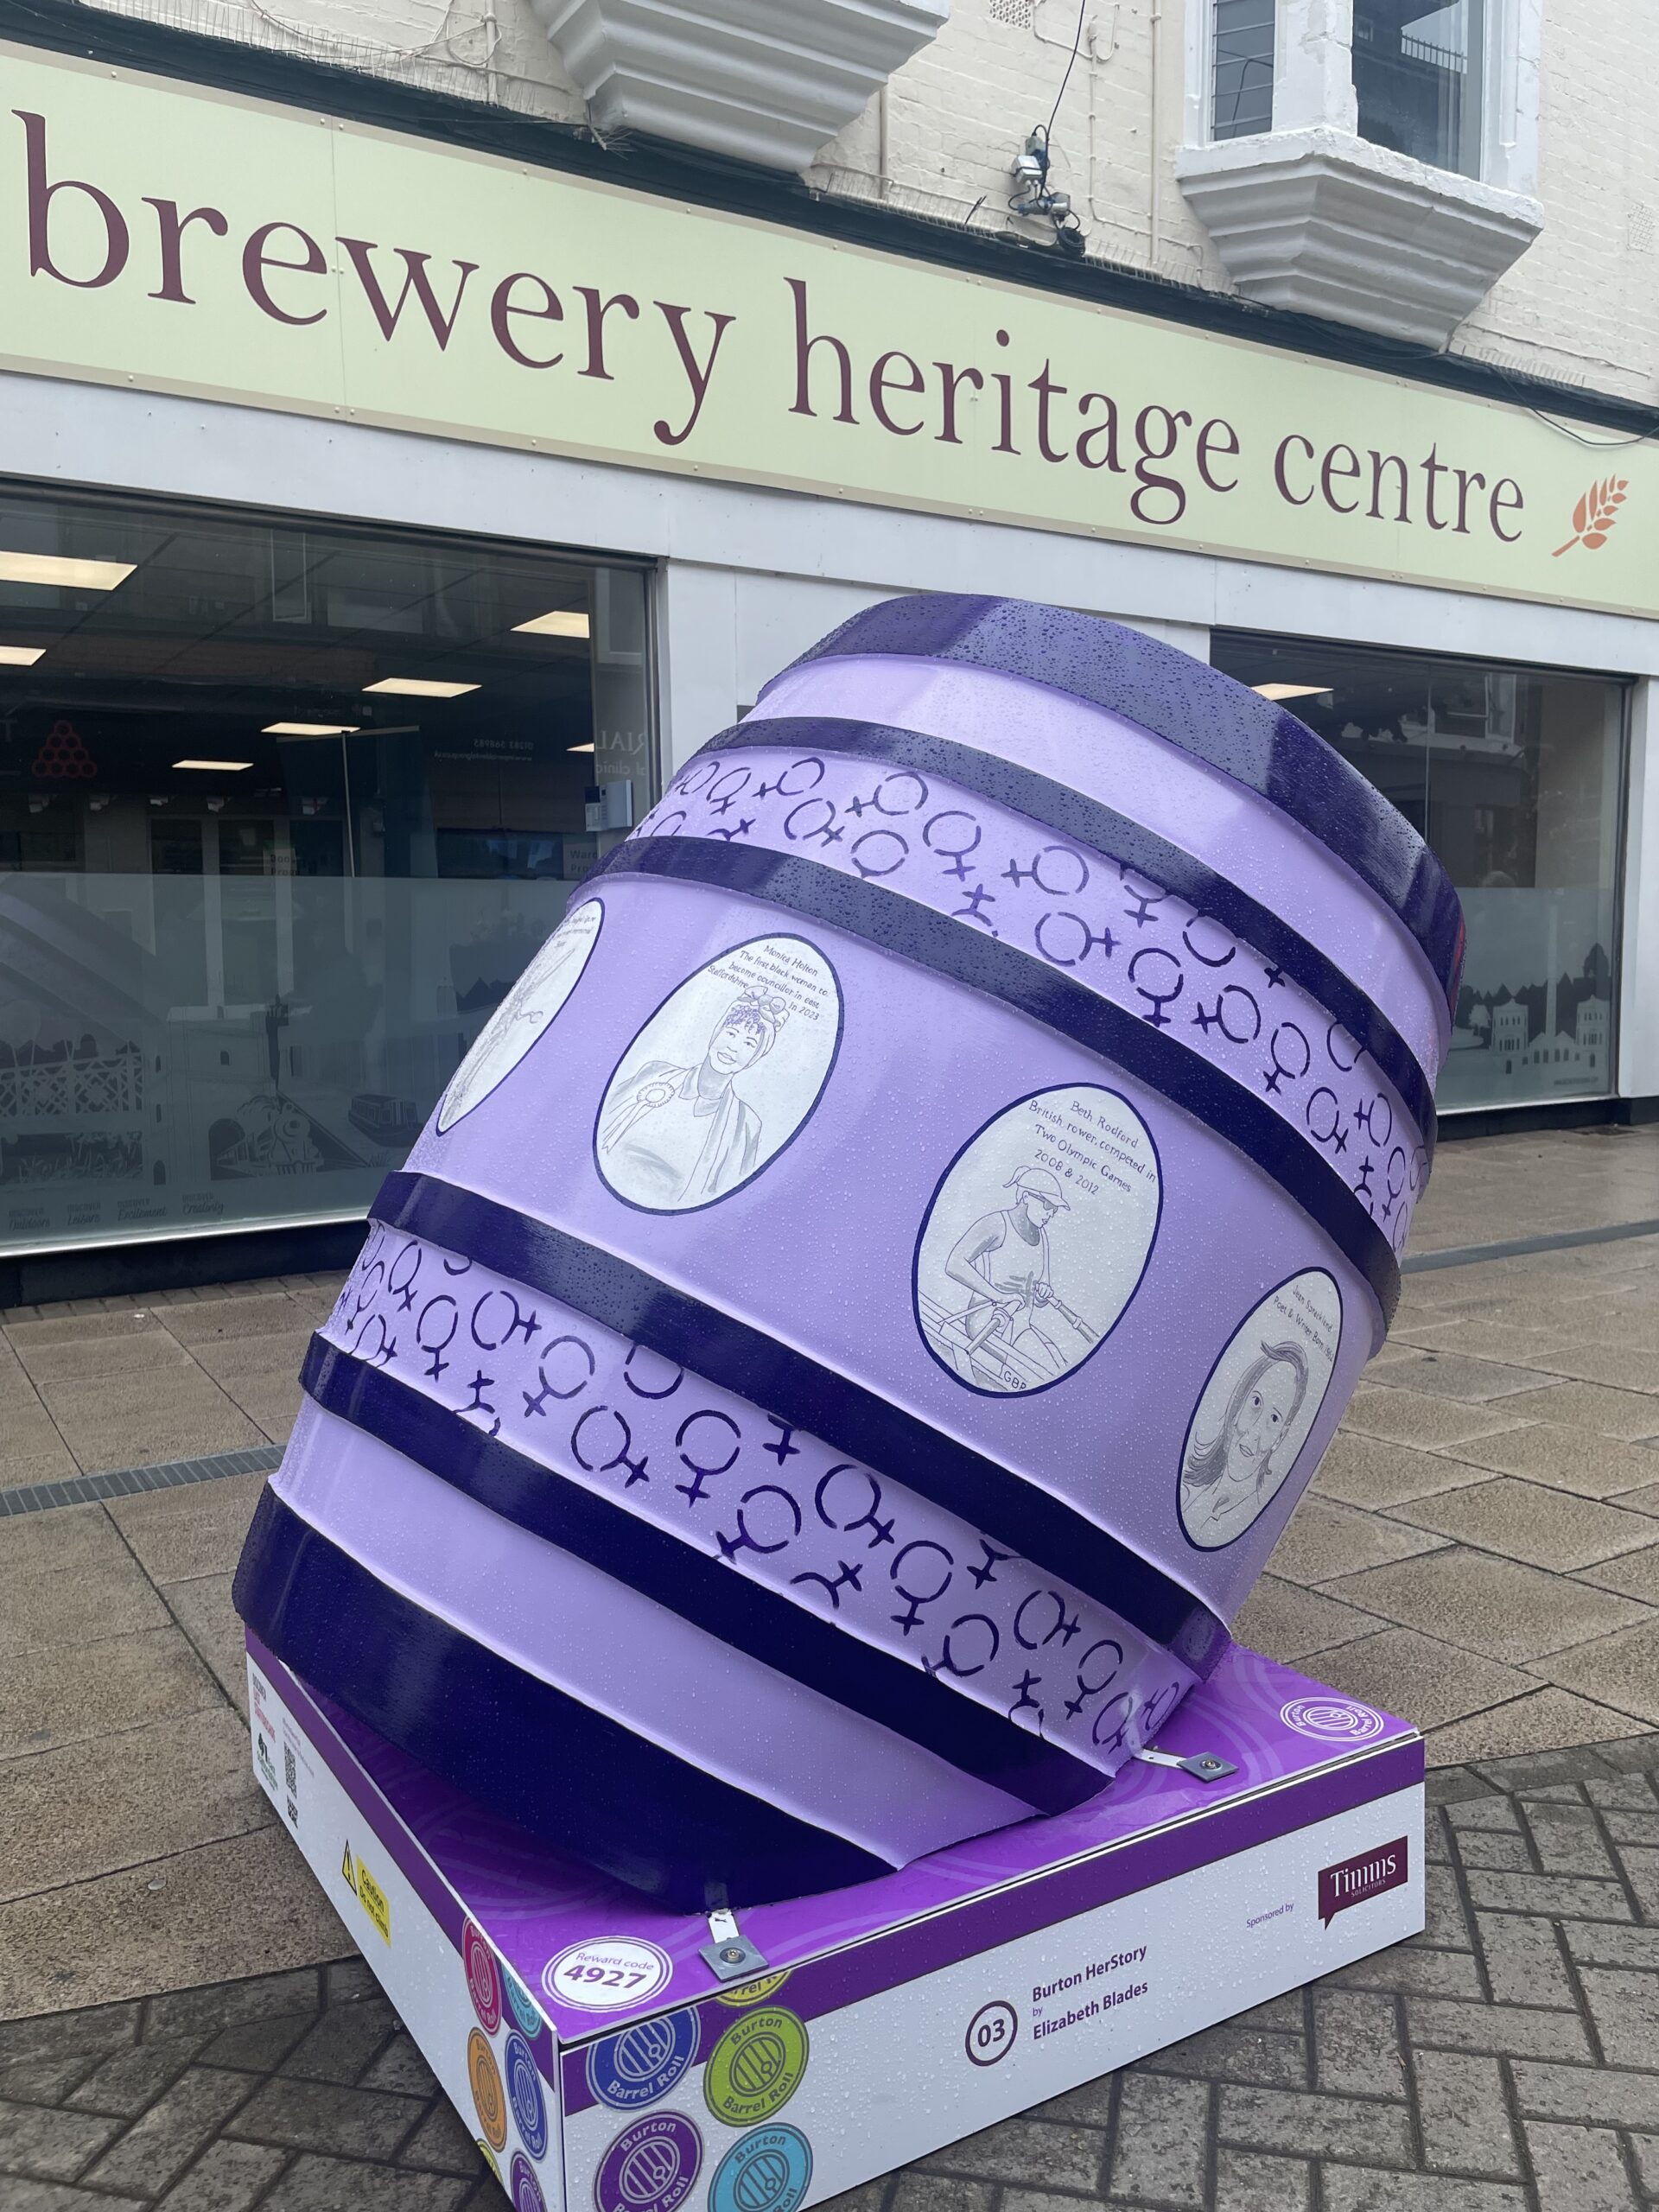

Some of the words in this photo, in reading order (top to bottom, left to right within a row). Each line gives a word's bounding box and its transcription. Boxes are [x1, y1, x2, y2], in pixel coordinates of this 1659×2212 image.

[11, 109, 737, 446] brewery
[783, 276, 1242, 524] heritage
[1274, 433, 1525, 542] centre
[739, 950, 753, 962] The
[753, 956, 769, 969] first
[770, 963, 789, 978] black
[791, 976, 816, 991] woman
[818, 988, 829, 996] to
[764, 945, 790, 964] Monica
[791, 958, 817, 976] Holton
[707, 965, 749, 988] Staffordshire
[728, 961, 756, 979] become
[757, 975, 794, 995] councillor
[794, 990, 802, 1001] in
[804, 997, 820, 1009] east
[798, 1005, 820, 1021] 2023
[1070, 1100, 1094, 1122] Beth
[1096, 1116, 1139, 1149] Rodford
[1028, 1099, 1063, 1126] British
[1066, 1123, 1098, 1146] rower,
[1099, 1140, 1146, 1174] competed
[1146, 1169, 1156, 1183] in
[1034, 1149, 1064, 1172] 2008
[1064, 1167, 1073, 1179] &
[1075, 1174, 1099, 1195] 2012
[1035, 1124, 1057, 1143] Two
[1057, 1139, 1097, 1169] Olympic
[1100, 1165, 1132, 1193] Games
[1273, 1295, 1287, 1315] Poet
[1291, 1704, 1307, 1726] Burton
[1345, 1706, 1370, 1719] Roll
[1349, 1717, 1373, 1736] Barrel
[1330, 1853, 1396, 1897] Timms
[1351, 1878, 1386, 1897] SOLICITORS
[1246, 1904, 1284, 1928] Sponsored
[1285, 1902, 1295, 1913] by
[563, 1964, 647, 1989] 4927
[575, 1952, 624, 1966] Reward
[623, 1961, 654, 1971] code
[1033, 1972, 1082, 2002] Burton
[1085, 1945, 1147, 1980] HerStory
[1033, 2000, 1099, 2040] Elizabeth
[1103, 1981, 1148, 2011] Blades
[1033, 2005, 1044, 2017] by
[730, 2016, 783, 2046] Burton
[977, 2018, 1006, 2048] 03
[607, 2079, 654, 2100] Barrel
[657, 2055, 685, 2087] Roll
[722, 2094, 766, 2114] Barrel
[768, 2072, 794, 2103] Roll
[620, 2121, 677, 2152] Burton
[734, 2134, 787, 2164] Burton
[661, 2176, 690, 2209] Roll
[772, 2187, 798, 2212] Roll
